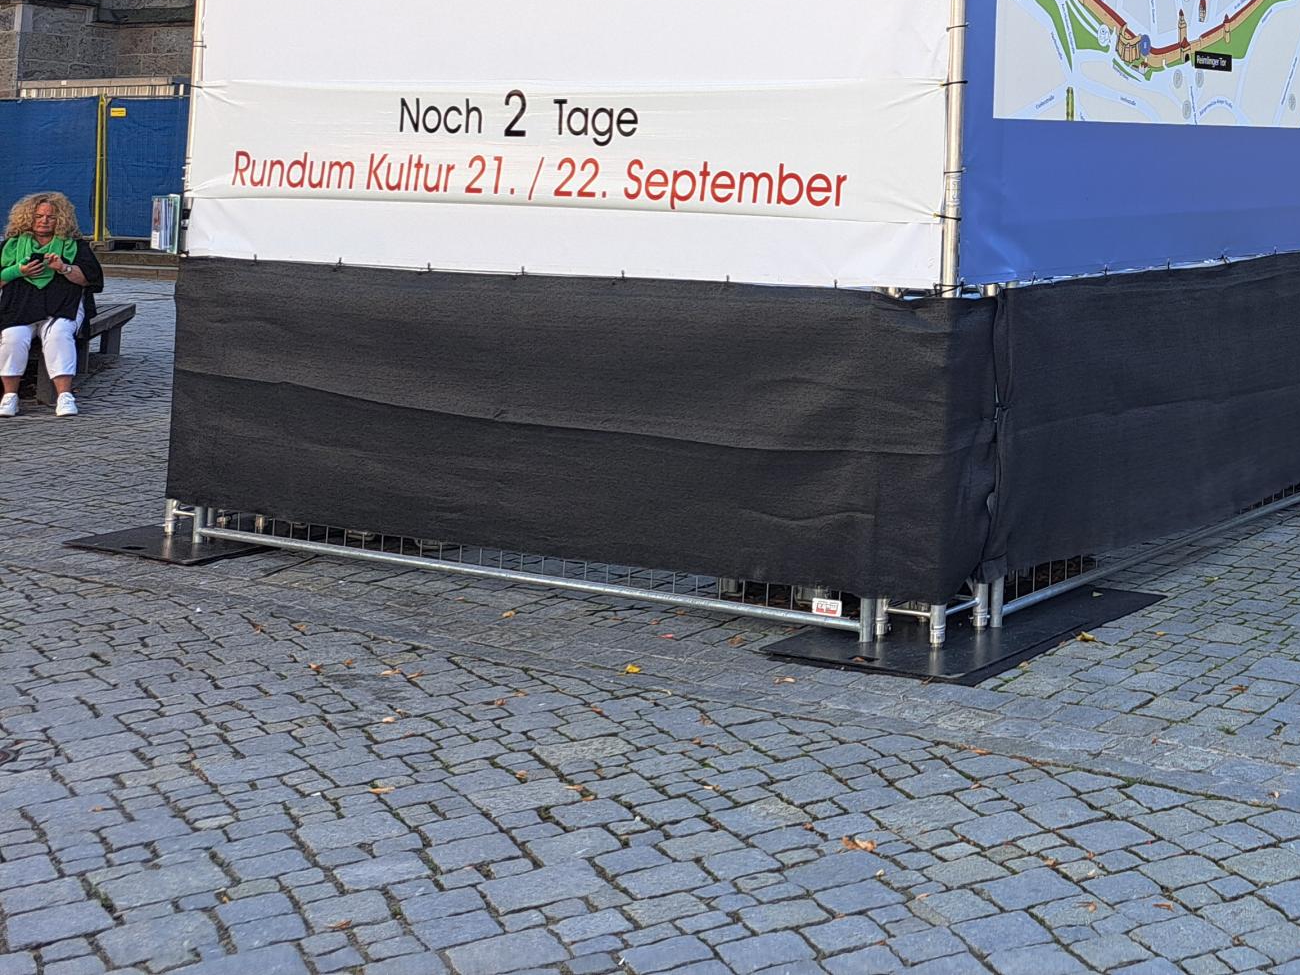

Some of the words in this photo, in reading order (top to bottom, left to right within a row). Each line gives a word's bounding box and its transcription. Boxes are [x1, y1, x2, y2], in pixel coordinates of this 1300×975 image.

[1196, 55, 1219, 68] Reimlinger
[399, 97, 483, 136] Noch
[503, 89, 527, 138] 2
[552, 98, 639, 147] Tage
[231, 150, 355, 190] Rundum
[365, 153, 456, 193] Kultur
[464, 154, 517, 196] 21.
[527, 156, 546, 201] /
[553, 157, 608, 199] 22.
[623, 158, 848, 211] September
